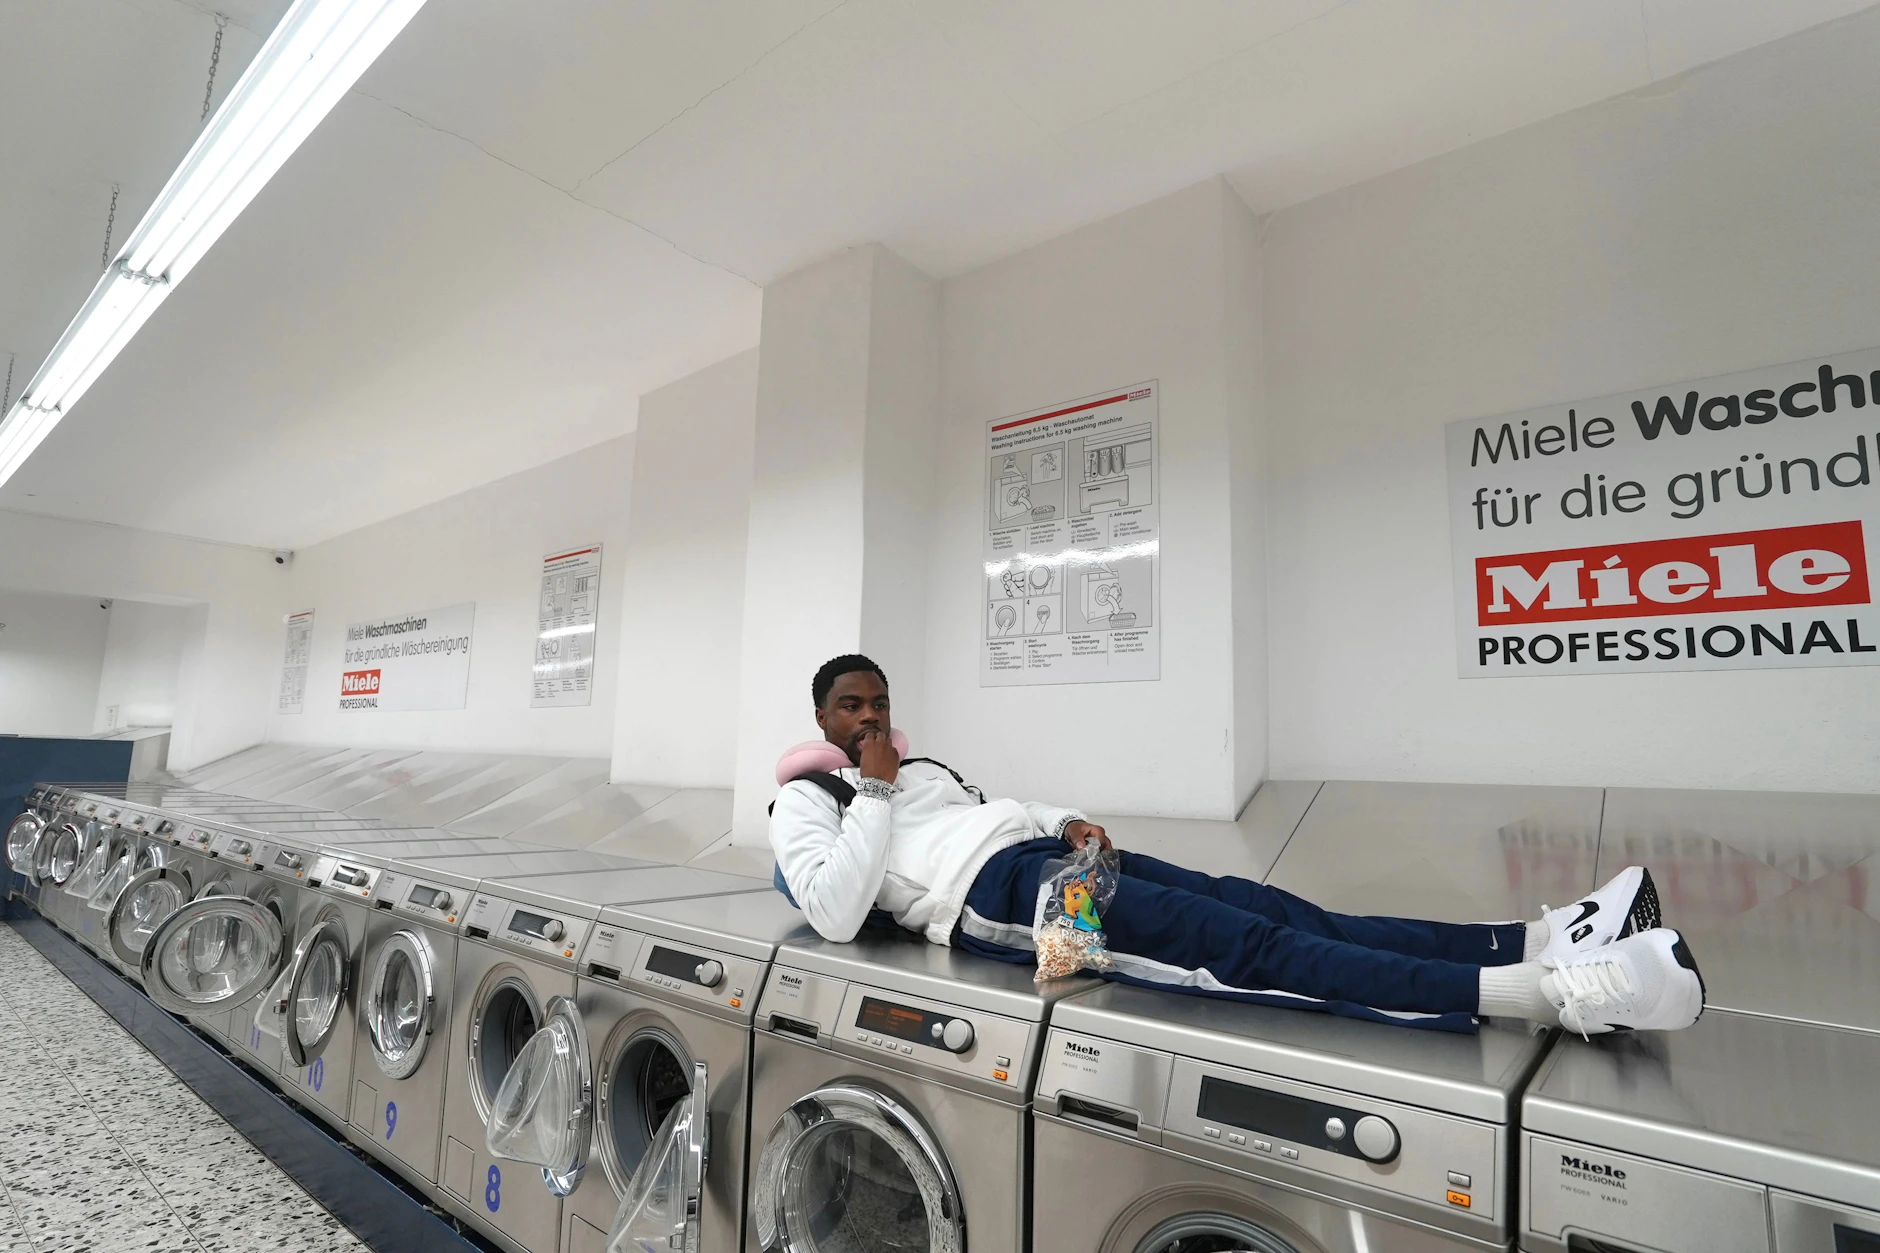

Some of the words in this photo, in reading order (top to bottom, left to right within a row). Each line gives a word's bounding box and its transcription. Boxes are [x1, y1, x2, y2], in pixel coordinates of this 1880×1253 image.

[991, 428, 1032, 442] Waschanleitung
[1053, 414, 1095, 428] Waschautomat
[991, 440, 1013, 450] Washing
[1014, 434, 1045, 446] instructions
[1073, 422, 1097, 433] washing
[1098, 416, 1122, 426] machine
[1471, 409, 1615, 466] Miele
[1472, 488, 1541, 530] für
[1560, 474, 1646, 519] die
[1486, 544, 1852, 614] Miele
[347, 626, 364, 641] Miele
[365, 616, 427, 638] Waschmaschinen
[1478, 618, 1877, 665] PROFESSIONAL
[345, 649, 353, 664] für
[354, 648, 364, 662] die
[364, 643, 400, 664] gründliche
[402, 636, 469, 656] Wäschereinigung
[343, 674, 379, 692] Miele
[339, 698, 378, 709] PROFESSIONAL
[781, 975, 802, 985] Miele
[1064, 1050, 1099, 1063] PROFESSIONAL
[1066, 1041, 1100, 1056] Miele
[308, 1056, 324, 1092] 10
[385, 1101, 397, 1140] 9
[1561, 1154, 1626, 1180] Miele
[1561, 1168, 1627, 1190] PROFESSIONAL
[485, 1164, 501, 1213] 8
[1601, 1194, 1628, 1206] VARIO
